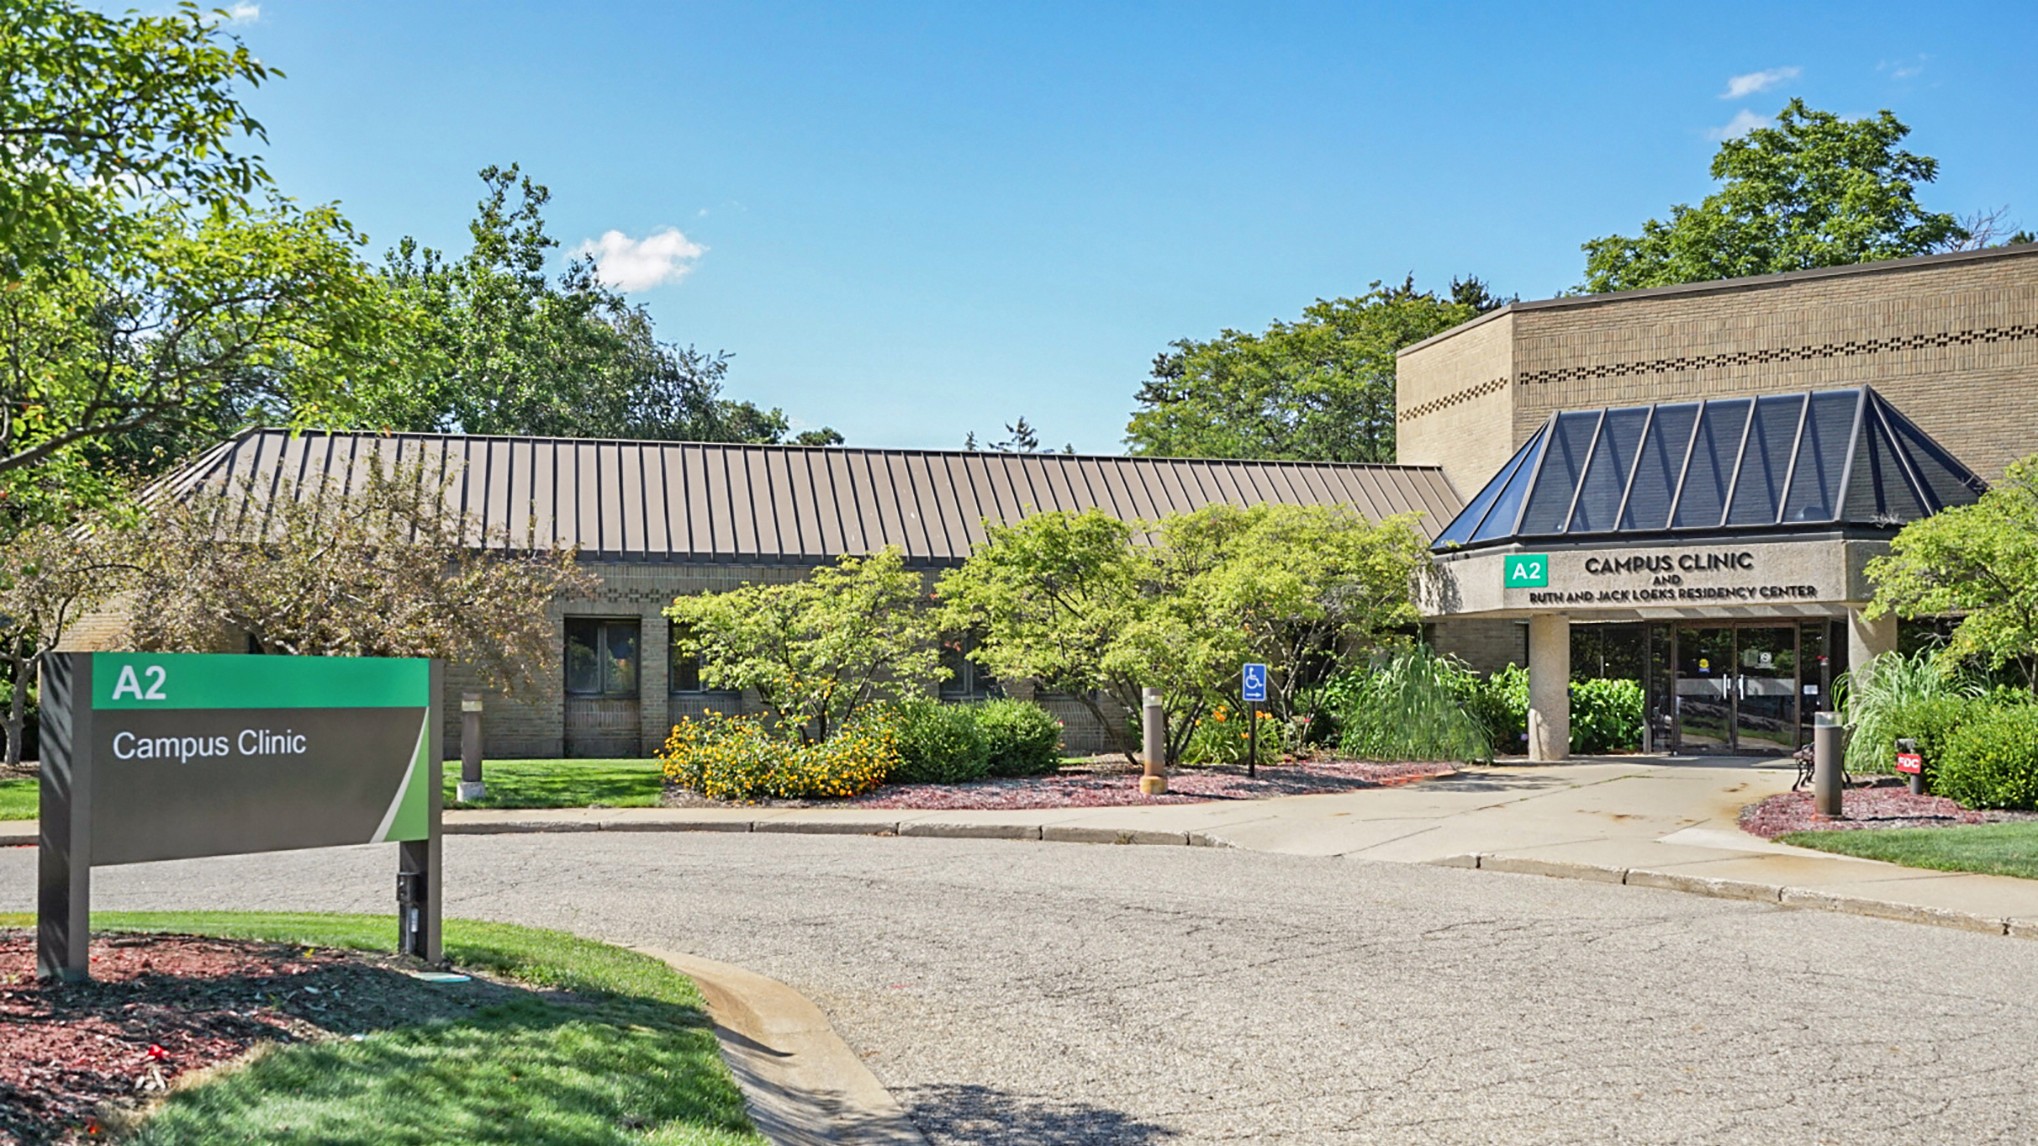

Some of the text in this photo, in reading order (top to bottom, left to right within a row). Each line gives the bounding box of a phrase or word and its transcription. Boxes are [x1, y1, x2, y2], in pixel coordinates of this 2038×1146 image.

[1512, 562, 1541, 580] A2
[1585, 552, 1753, 574] CAMPUS CLINIC
[1653, 575, 1682, 586] AND
[1530, 585, 1816, 603] RUTH AND JACK LOEKS RESIDENCY CENTER
[112, 665, 167, 700] A2
[113, 729, 307, 764] Campus Clinic
